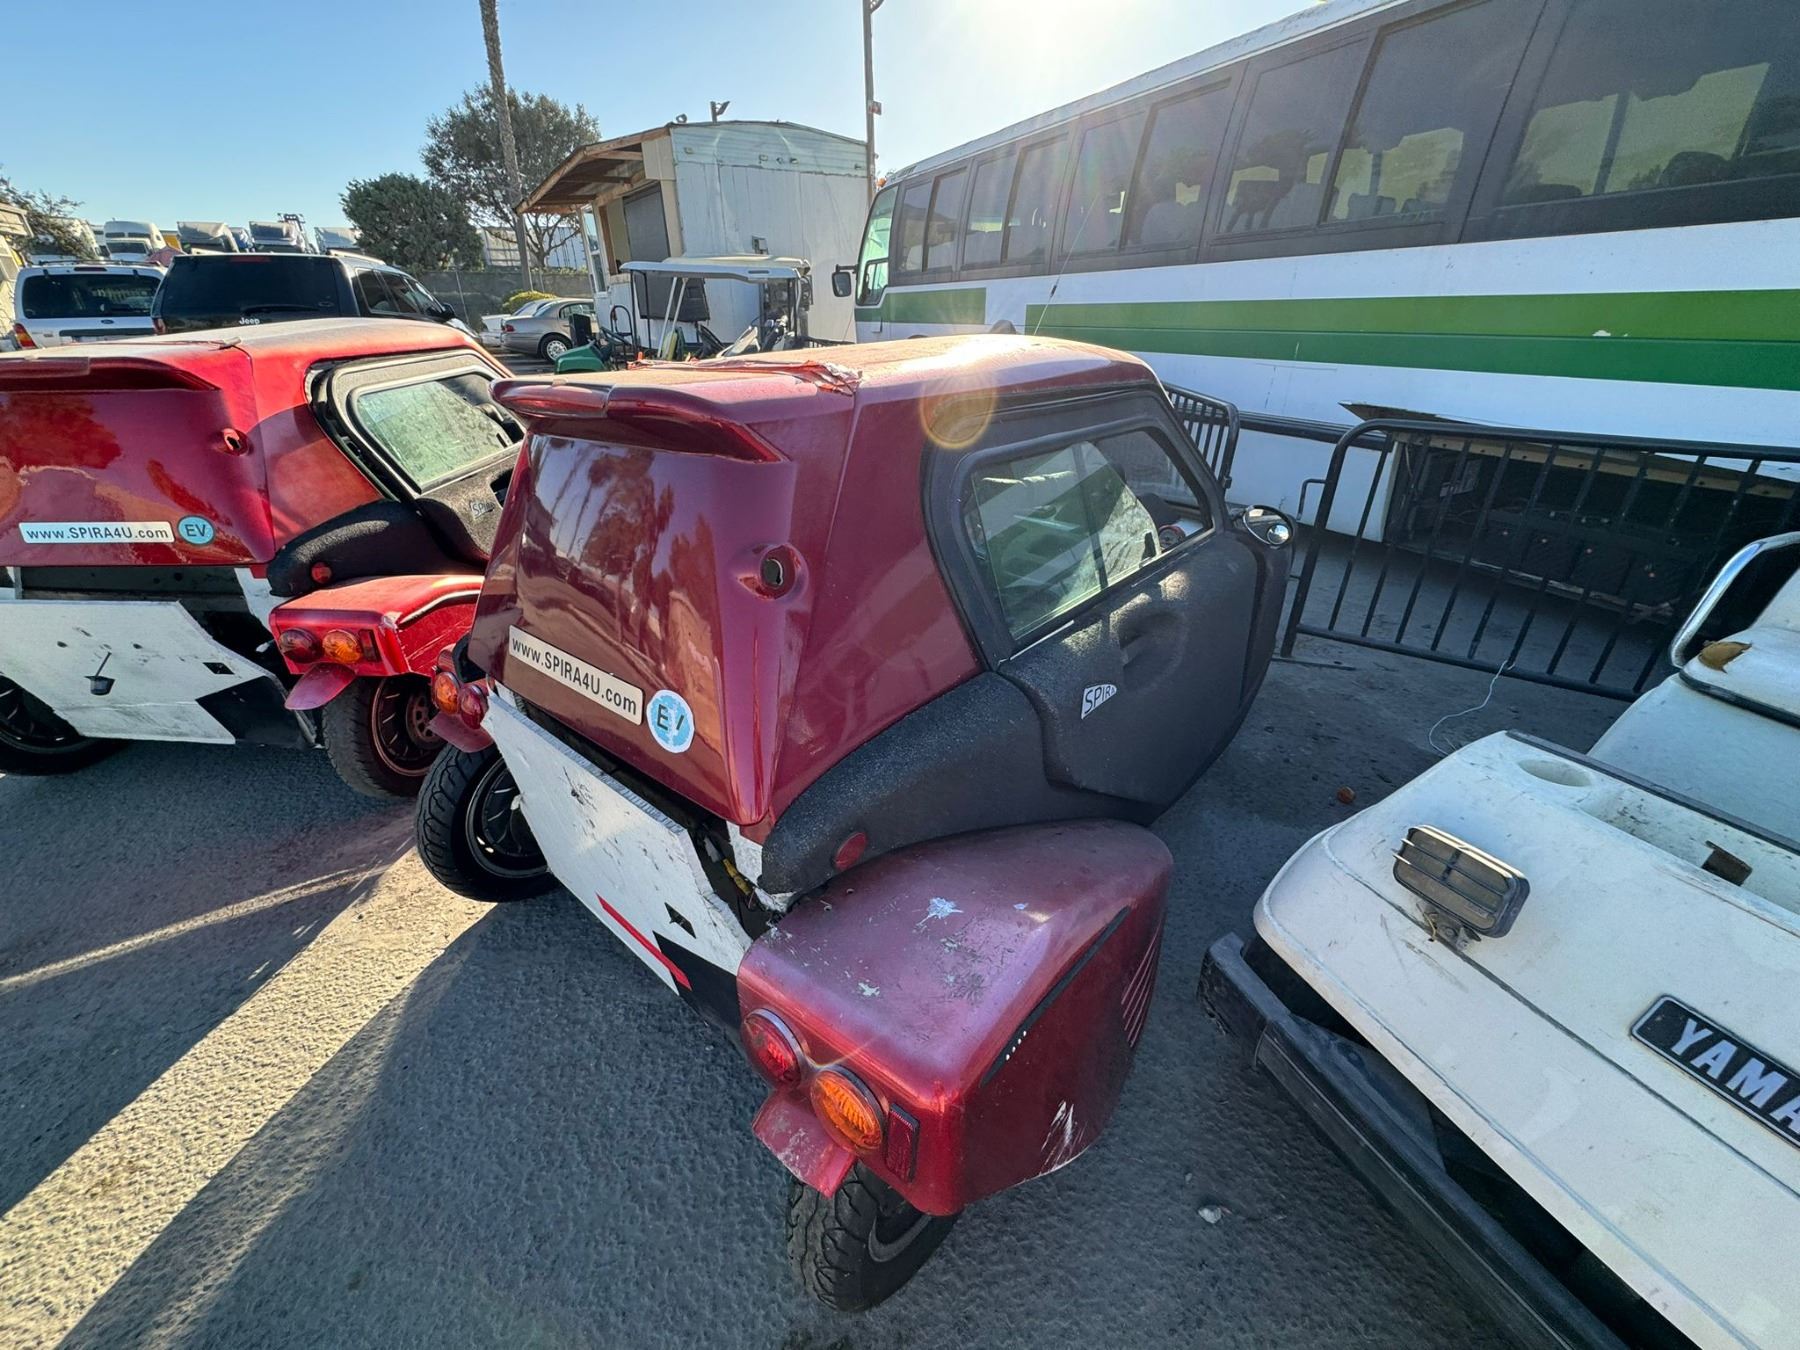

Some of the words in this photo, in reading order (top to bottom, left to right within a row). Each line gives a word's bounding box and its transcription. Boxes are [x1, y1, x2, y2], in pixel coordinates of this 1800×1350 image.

[27, 526, 168, 540] www.SPIRA4U.com
[185, 524, 207, 537] EV
[512, 638, 637, 716] www.SPIRA4U.com
